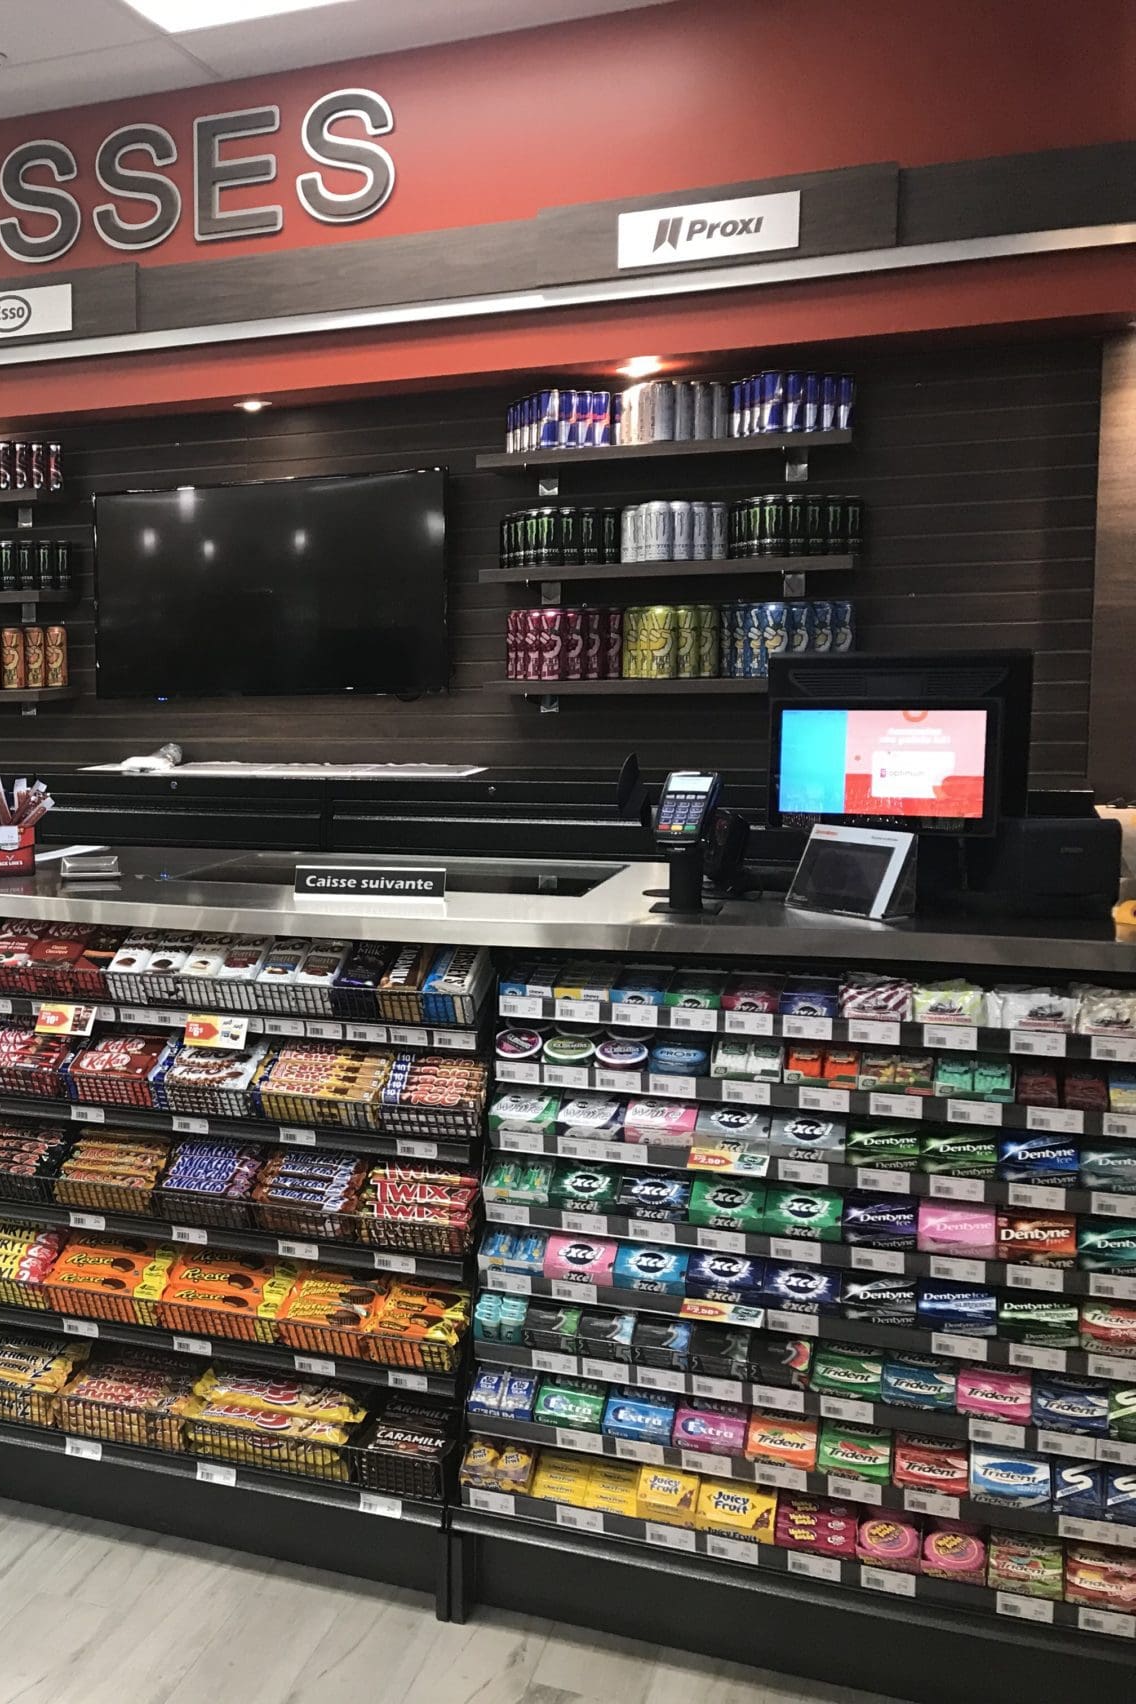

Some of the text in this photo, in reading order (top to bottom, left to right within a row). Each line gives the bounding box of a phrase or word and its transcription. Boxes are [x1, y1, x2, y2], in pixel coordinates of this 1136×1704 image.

[686, 216, 763, 241] Proxi
[305, 875, 434, 890] Caisse suivante
[710, 1111, 758, 1124] excel
[784, 1122, 834, 1136] excel
[864, 1136, 917, 1146] Dentyne
[939, 1143, 995, 1153] Dentyne
[1017, 1148, 1075, 1160] Dentyne
[166, 1178, 226, 1192] SNICKERS
[564, 1177, 612, 1190] excel
[632, 1184, 680, 1197] excel
[272, 1189, 325, 1202] SNICKERS
[371, 1179, 448, 1203] TWIX
[705, 1192, 753, 1203] excel
[368, 1201, 449, 1219] TWIX
[780, 1200, 830, 1214] excel
[860, 1212, 914, 1222] Dentyne
[936, 1221, 992, 1231] Dentyne
[1000, 1228, 1071, 1241] Dentyne
[559, 1245, 606, 1260] excel
[628, 1255, 676, 1270] excel
[701, 1259, 751, 1273] excel
[777, 1275, 828, 1289] excel
[859, 1290, 914, 1300] Dentyne
[924, 1292, 971, 1301] Dentyne
[1004, 1302, 1052, 1311] Dentyne
[821, 1366, 871, 1382] Trident
[893, 1377, 944, 1393] Trident
[968, 1387, 1020, 1403] Trident
[549, 1398, 592, 1415] Extra
[1043, 1399, 1097, 1416] Trident
[618, 1409, 662, 1426] Extra
[687, 1420, 734, 1439] Extra
[376, 1429, 446, 1448] CARAMILK
[757, 1434, 806, 1450] Trident
[828, 1447, 880, 1463] Trident
[905, 1461, 956, 1478] Trident
[981, 1467, 1037, 1483] Trident
[649, 1475, 681, 1488] Juicy
[650, 1484, 679, 1495] Fruit
[714, 1491, 749, 1505] Juicy
[714, 1501, 748, 1514] Fruit
